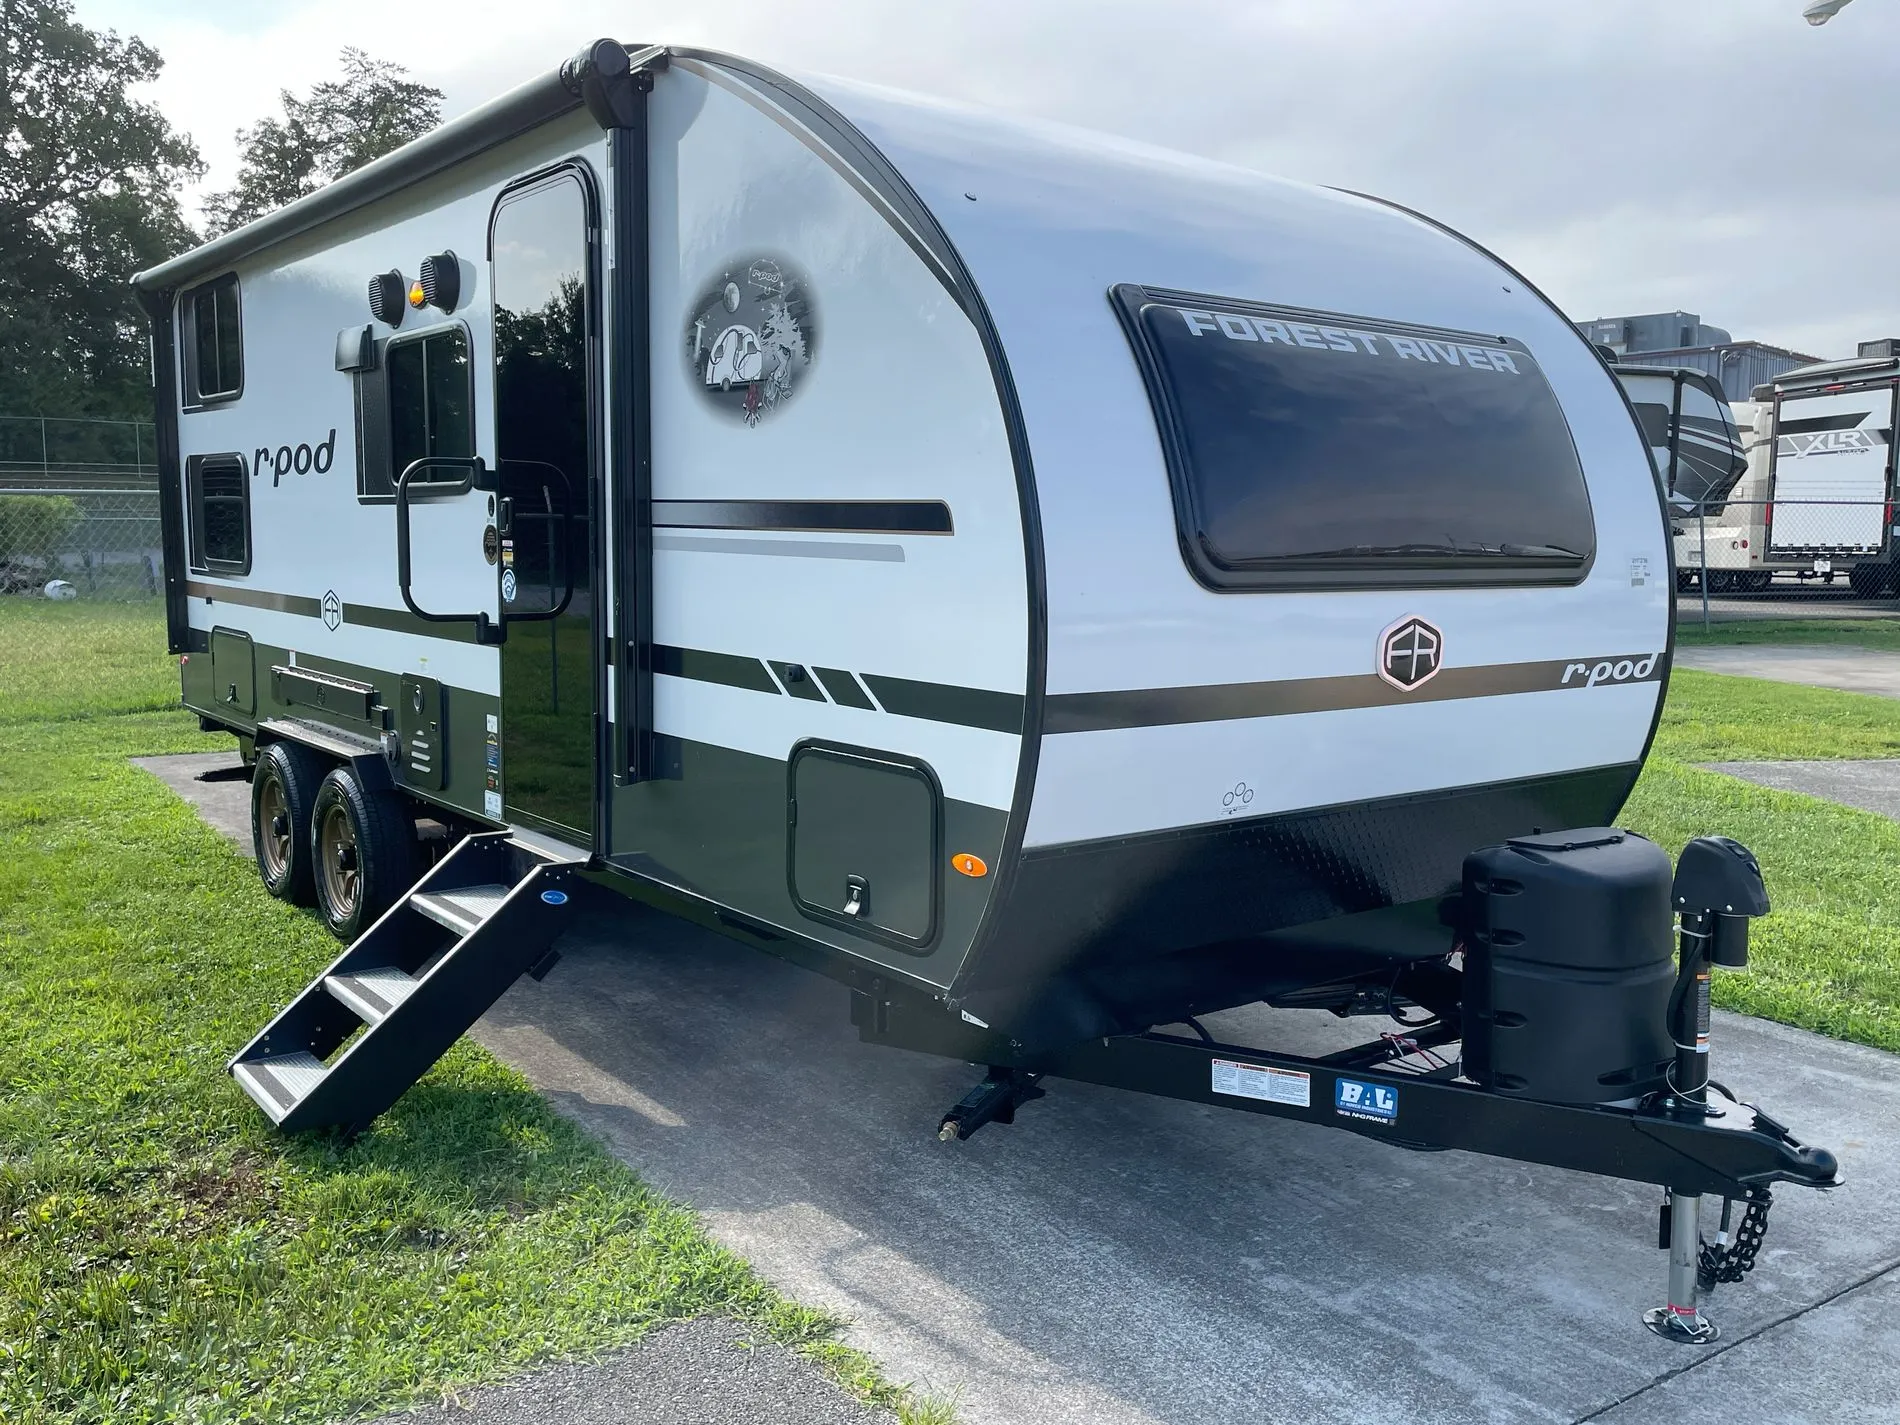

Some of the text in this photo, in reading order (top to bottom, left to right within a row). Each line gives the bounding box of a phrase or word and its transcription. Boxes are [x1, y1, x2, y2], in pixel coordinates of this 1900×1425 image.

[1176, 309, 1520, 375] FOREST RIVER
[1795, 431, 1861, 459] XLR
[1340, 1081, 1393, 1110] BAL
